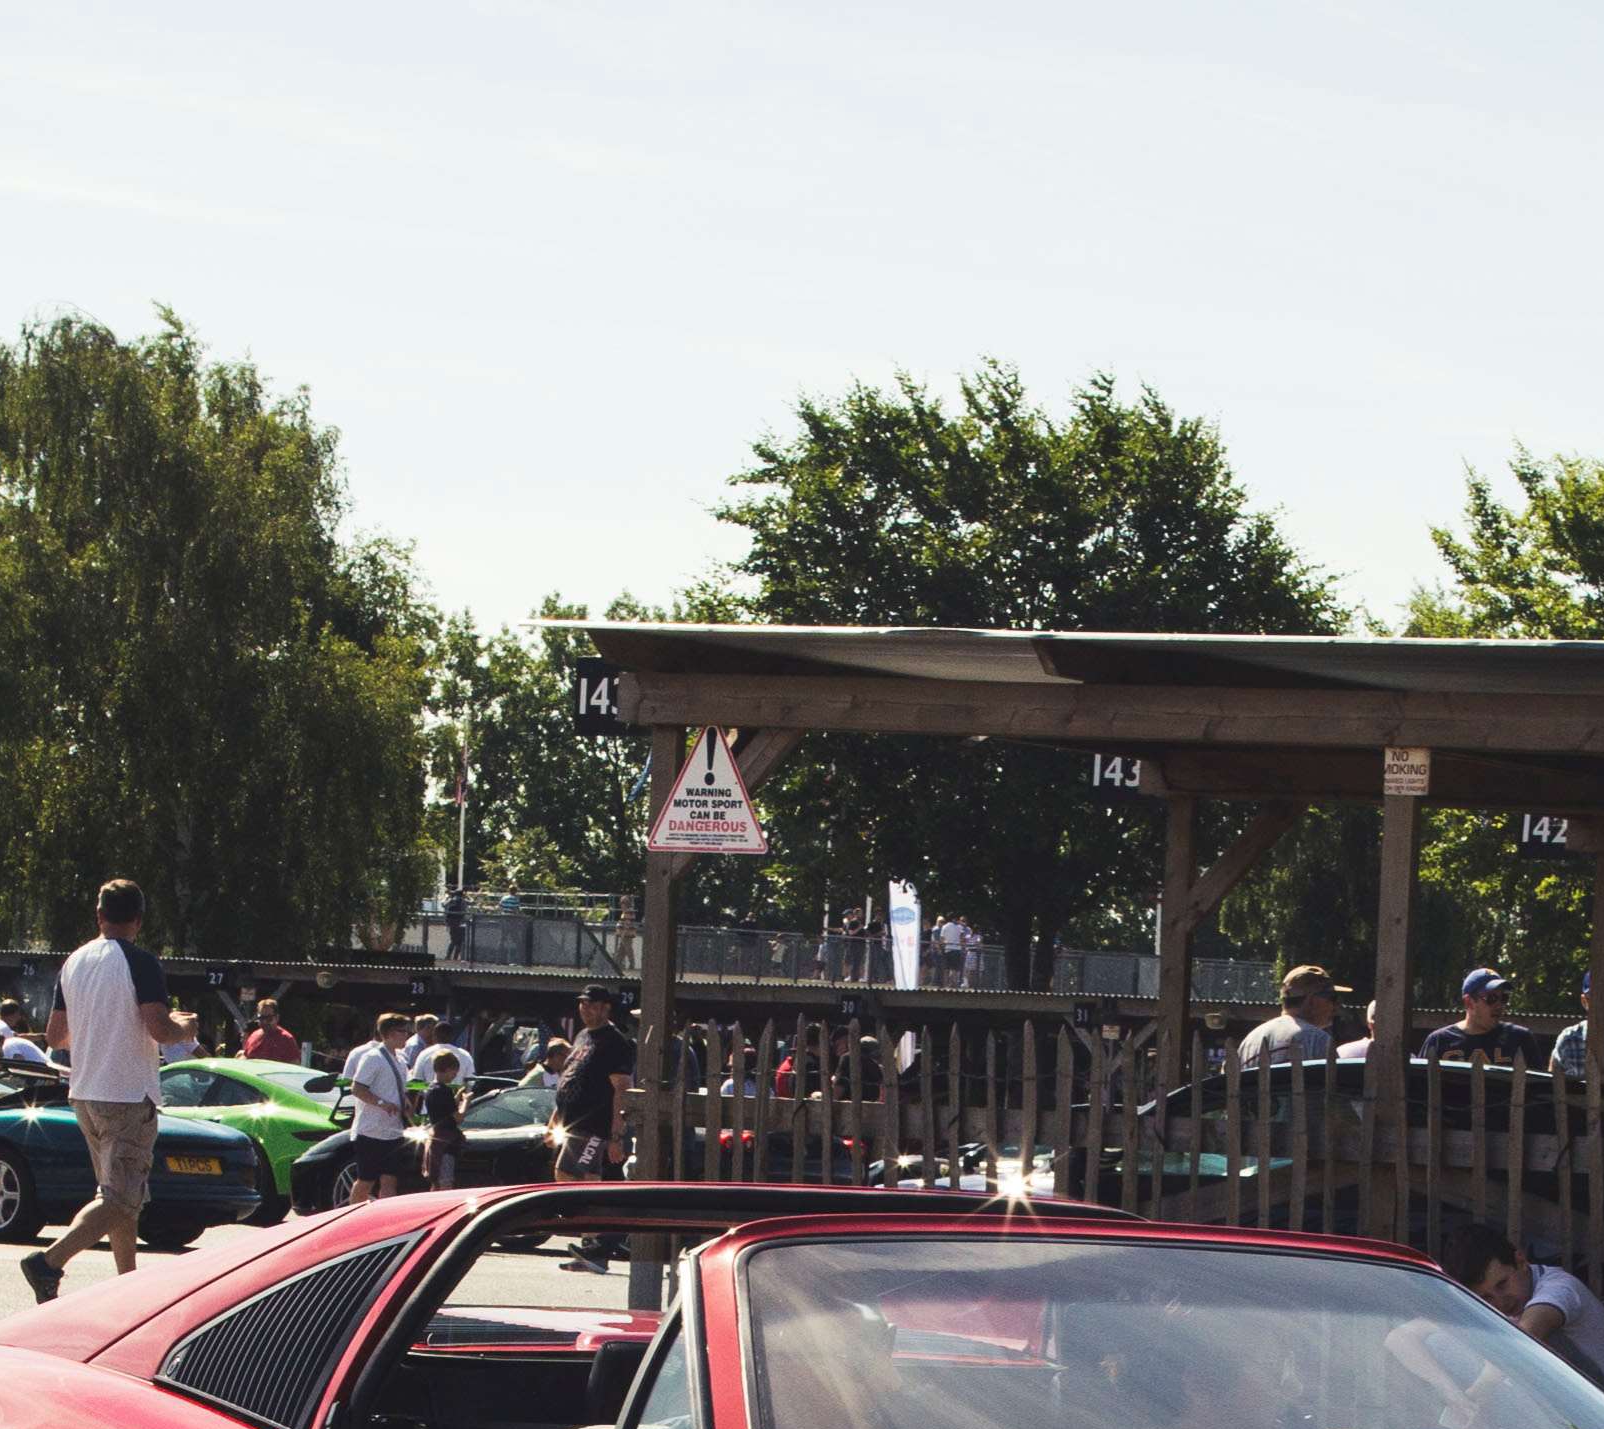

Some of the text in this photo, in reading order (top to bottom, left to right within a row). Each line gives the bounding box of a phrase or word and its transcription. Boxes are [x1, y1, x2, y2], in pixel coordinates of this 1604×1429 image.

[1392, 750, 1409, 762] NO
[1093, 753, 1141, 787] 143
[685, 788, 732, 798] WARNING
[673, 799, 743, 809] MOTOR SPORT
[689, 810, 726, 820] CAN BE
[668, 820, 747, 833] DANGEROUS
[1522, 814, 1568, 843] 142
[209, 972, 224, 985] 27
[411, 982, 425, 994] 28
